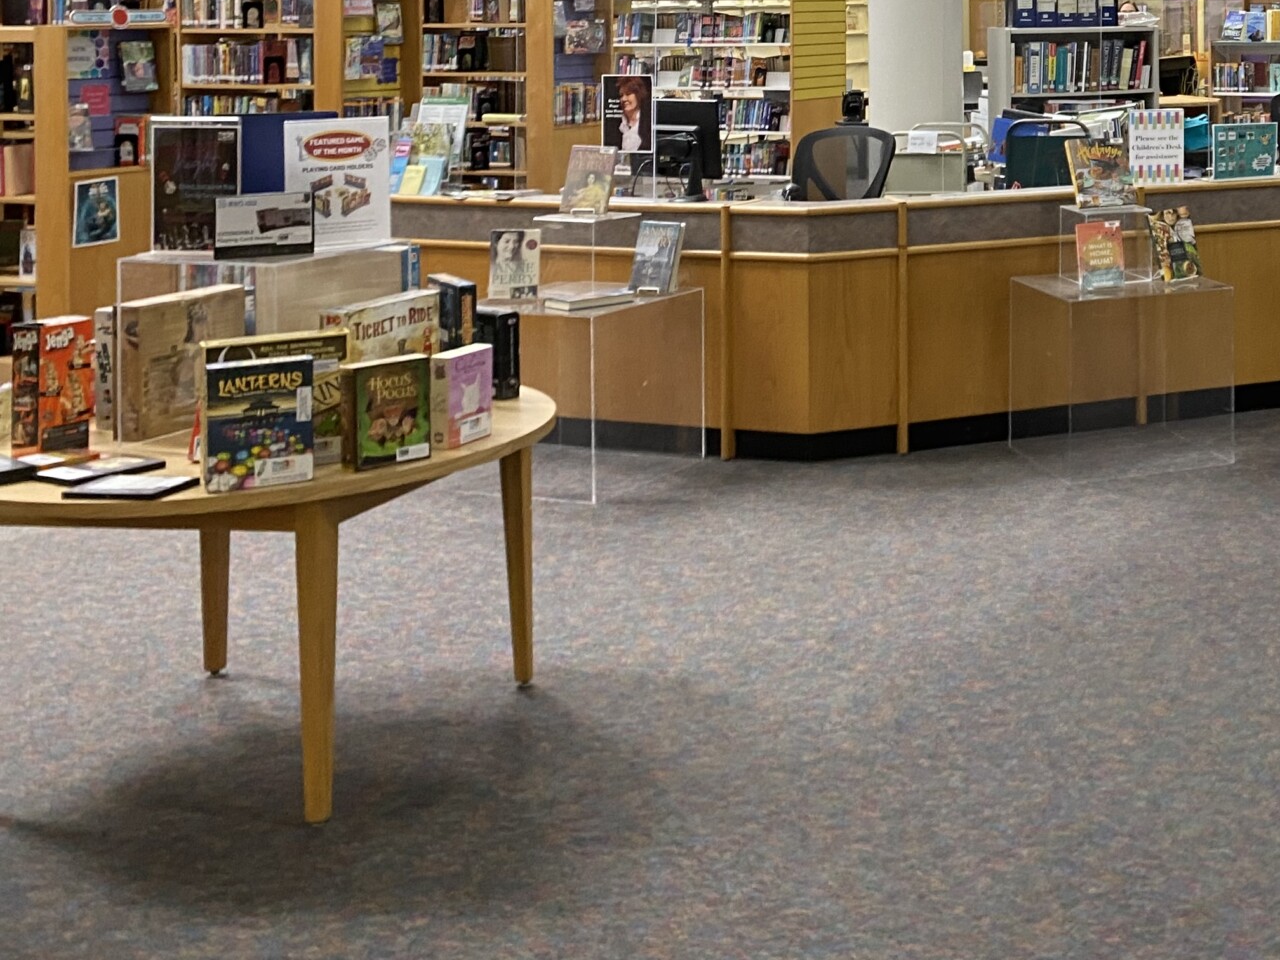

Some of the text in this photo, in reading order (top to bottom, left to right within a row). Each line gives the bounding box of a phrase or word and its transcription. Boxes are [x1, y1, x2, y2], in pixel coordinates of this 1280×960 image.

[309, 138, 345, 146] FEATURED
[324, 147, 337, 155] THE
[338, 146, 362, 154] MONTH
[302, 165, 328, 173] PLAYING
[347, 163, 374, 171] HOLDERS
[492, 273, 536, 285] PERRY
[353, 316, 395, 340] TICKET
[396, 315, 406, 328] TO
[409, 306, 433, 325] RIDE
[13, 329, 38, 351] Jenga
[45, 327, 74, 351] Jenga
[218, 371, 303, 397] LANTERNS
[368, 373, 412, 390] HOCUS
[376, 386, 417, 403] POCUS
